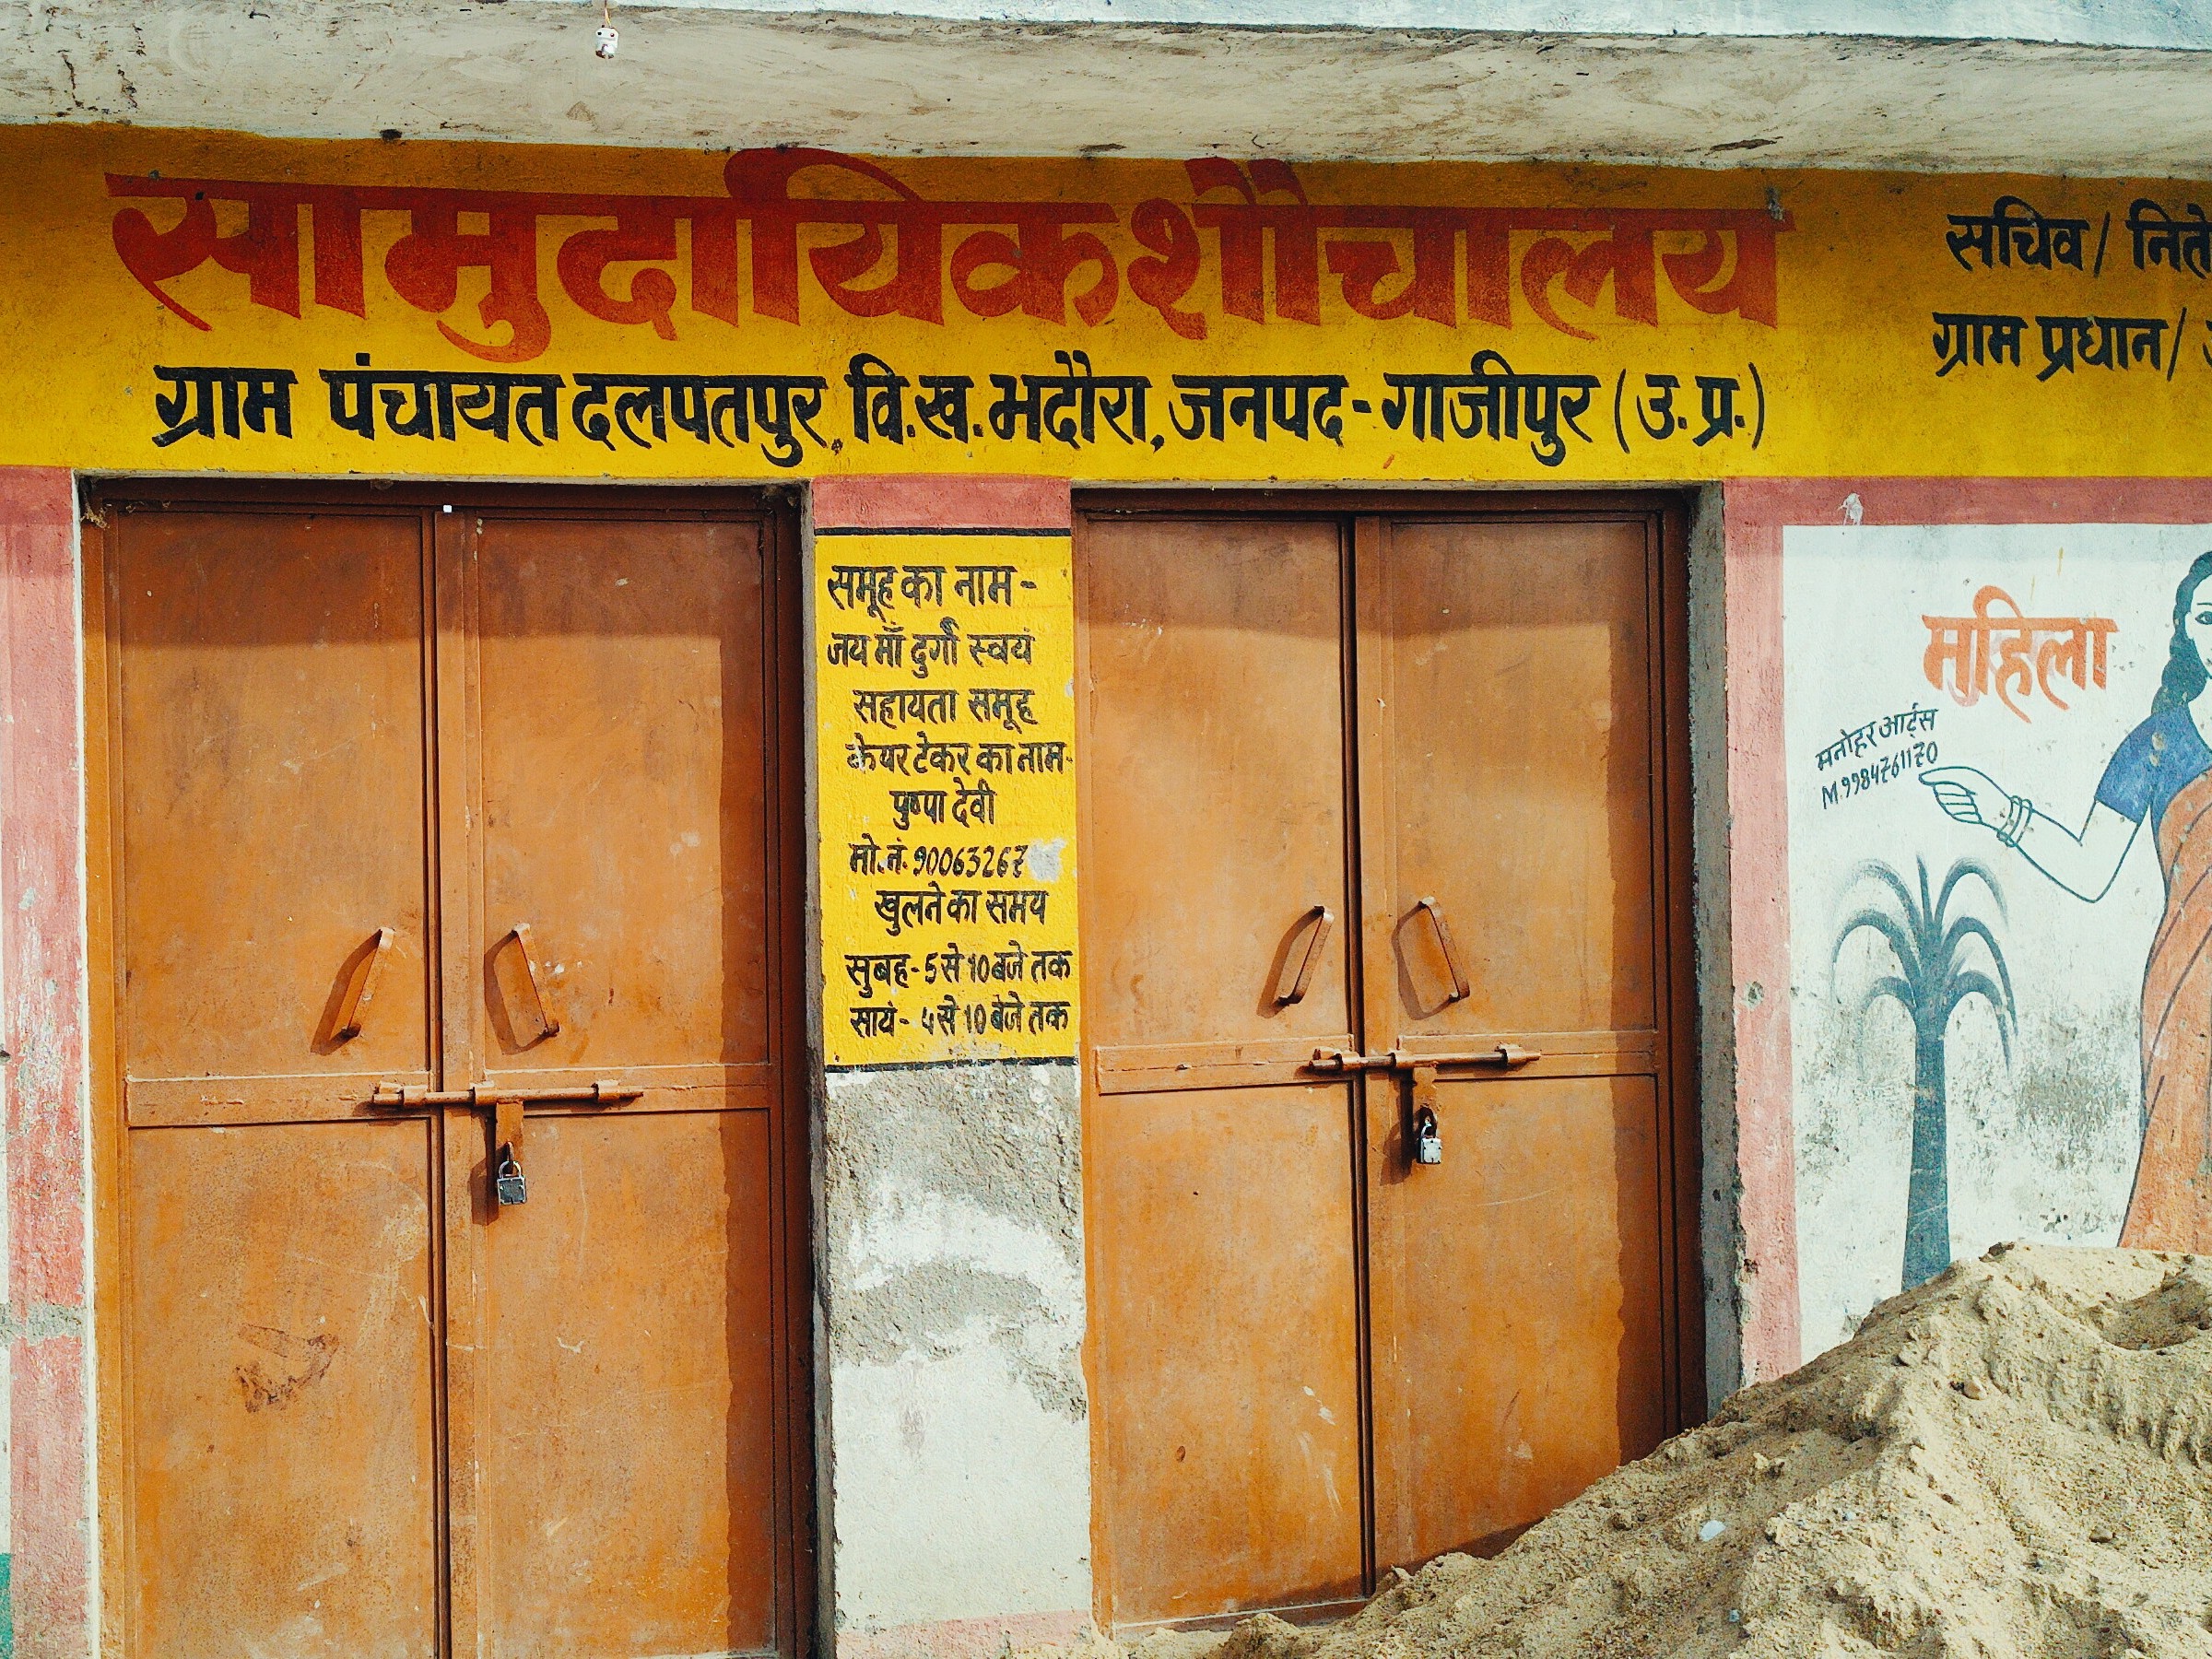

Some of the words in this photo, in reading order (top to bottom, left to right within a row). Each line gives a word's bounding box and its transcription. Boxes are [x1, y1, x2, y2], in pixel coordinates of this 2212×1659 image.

[104, 147, 1119, 362] सामुदायिक
[1128, 156, 1795, 341] शौचालय
[2124, 196, 2212, 280] निते
[1931, 312, 2029, 378] ग्राम
[151, 364, 299, 448] ग्राम
[318, 352, 565, 447] पंचायत
[827, 564, 899, 623] समूह
[900, 564, 947, 607] का
[827, 632, 868, 668] जय
[1922, 585, 2119, 724] महिला
[852, 688, 960, 730] सहायता
[968, 688, 1039, 735] समूह
[975, 743, 1017, 775] का
[1815, 722, 1877, 771] मनोहर
[888, 790, 948, 831] पुष्पा
[951, 776, 996, 829] देवी
[912, 844, 1029, 878] 90063267
[874, 880, 947, 937] खुलने
[946, 889, 983, 924] का
[985, 889, 1050, 925] समय
[1030, 949, 1074, 984] तक
[1028, 1000, 1072, 1035] तक
